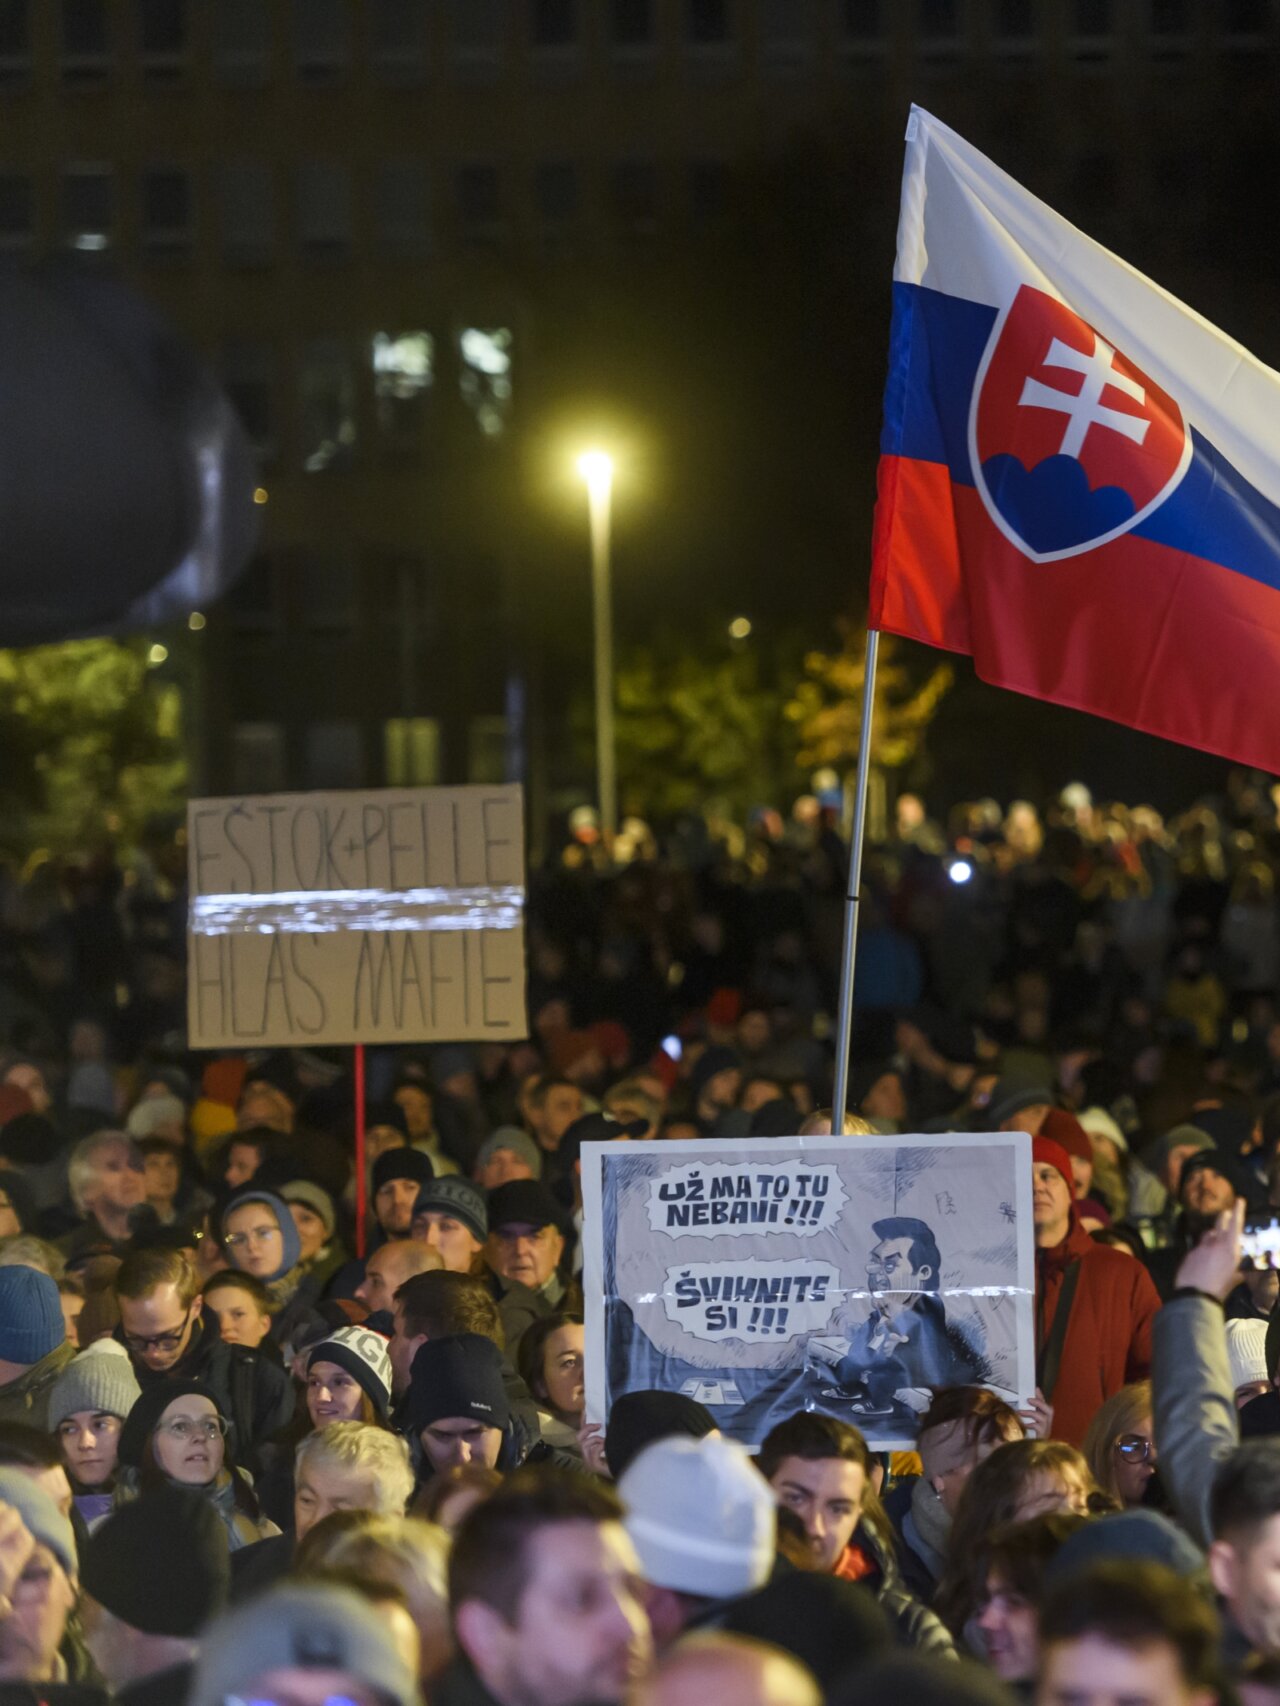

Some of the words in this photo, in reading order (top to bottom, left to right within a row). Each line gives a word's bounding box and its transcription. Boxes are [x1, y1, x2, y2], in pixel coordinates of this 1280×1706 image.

[196, 931, 326, 1038] HLAS
[353, 930, 511, 1031] MAFIE
[658, 1171, 705, 1201] UŽ
[709, 1175, 752, 1200] MA
[756, 1174, 790, 1198] TO
[796, 1174, 829, 1198] TU
[675, 1270, 830, 1308] ŠVIHNITE
[705, 1305, 738, 1331] SI
